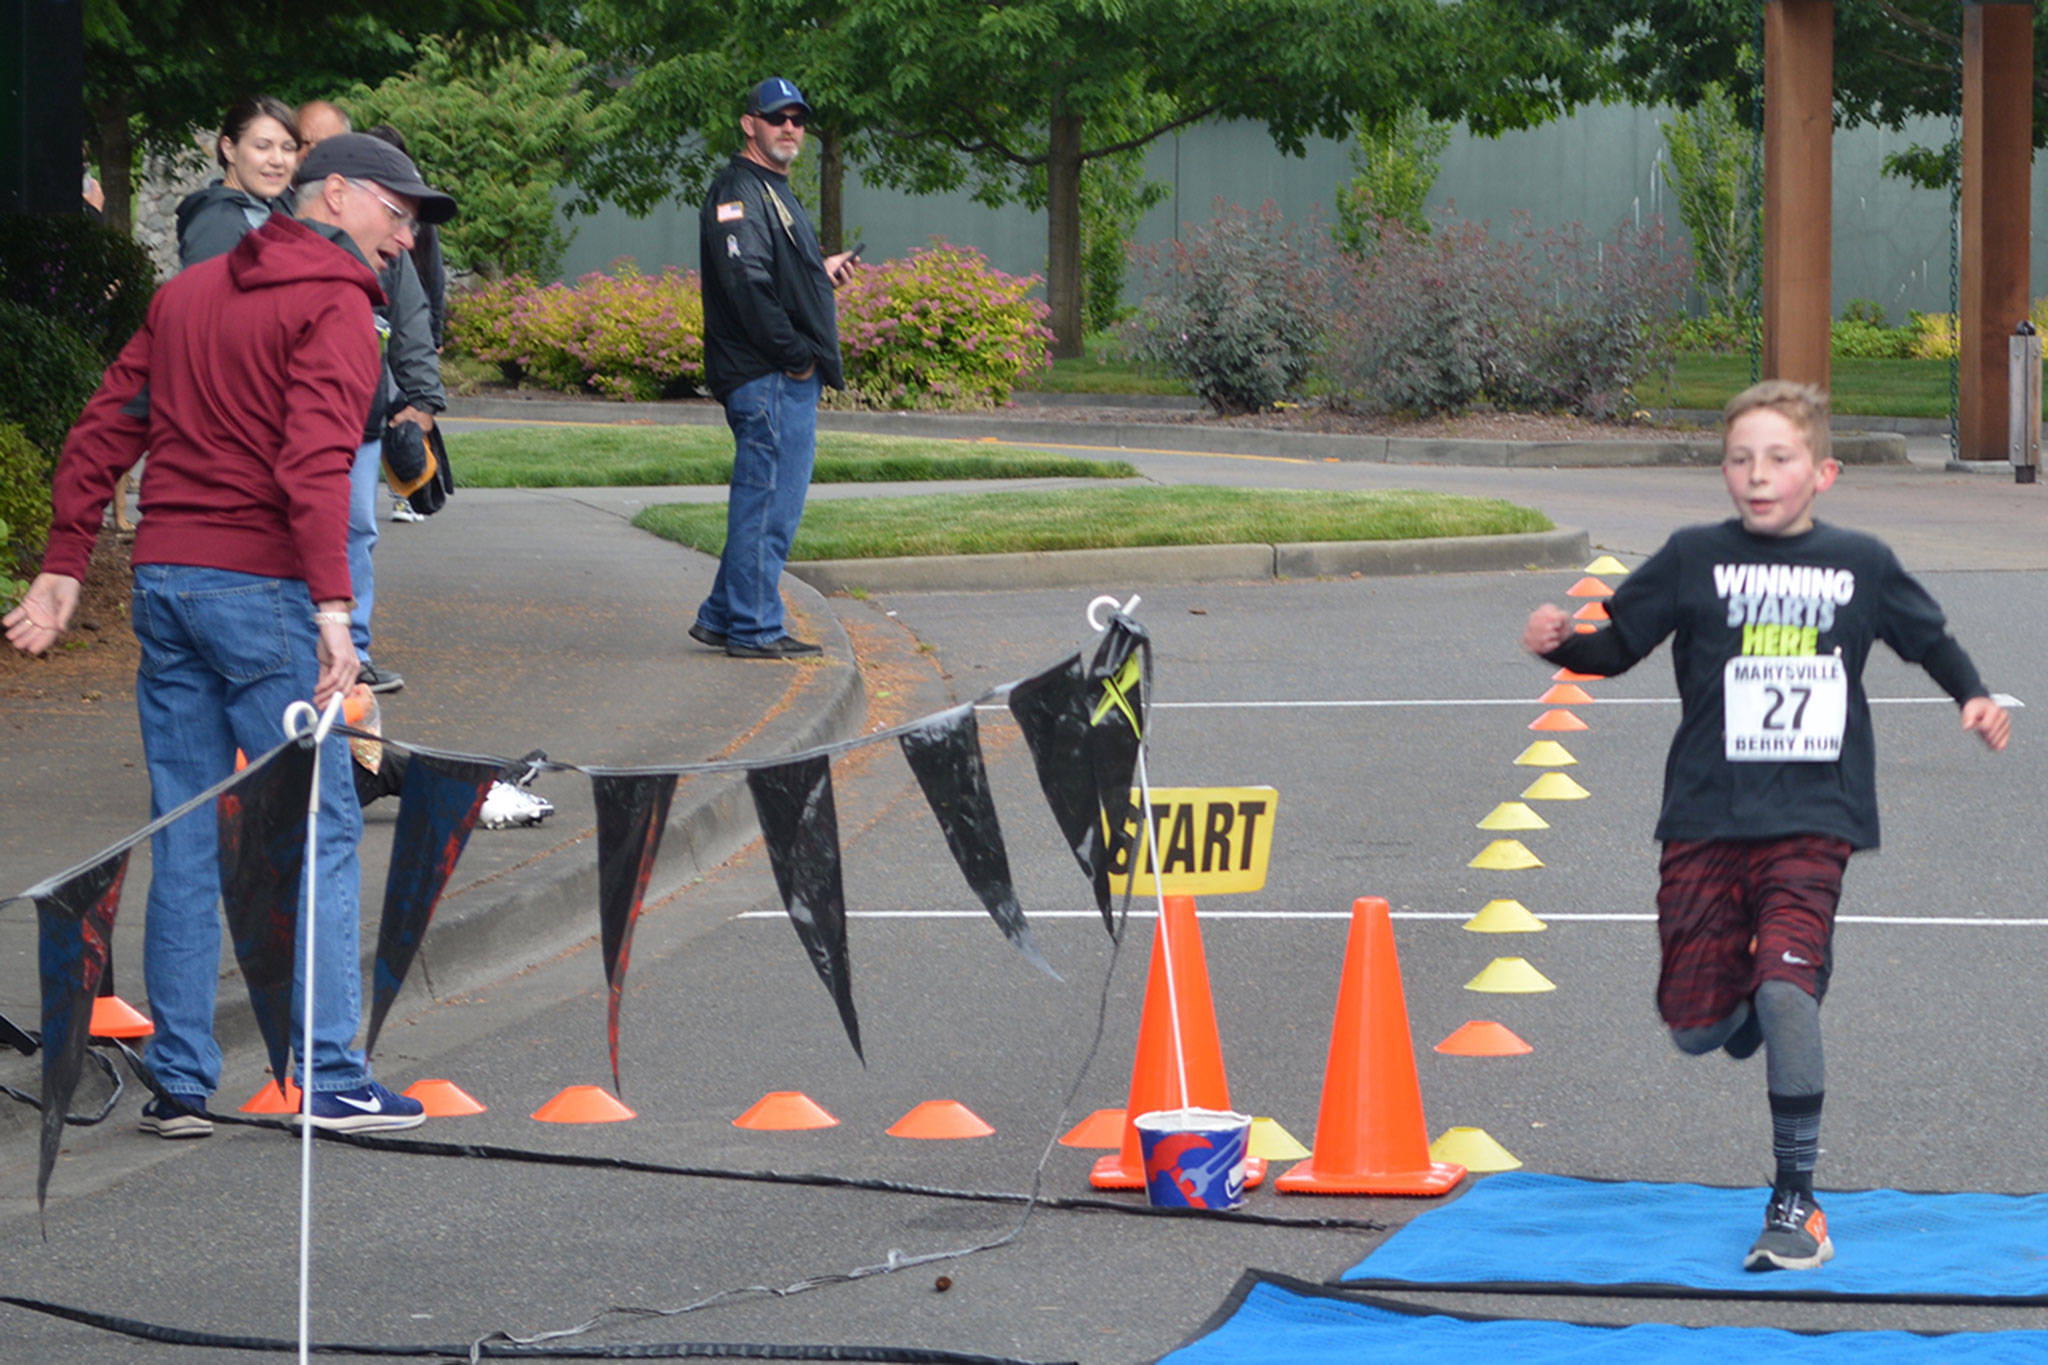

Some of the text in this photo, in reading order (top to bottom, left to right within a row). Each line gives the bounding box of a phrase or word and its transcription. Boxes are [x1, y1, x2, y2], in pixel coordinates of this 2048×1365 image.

[1714, 564, 1855, 605] WINNING
[1727, 597, 1836, 632] STARTS
[1742, 623, 1819, 656] HERE
[1735, 664, 1839, 680] MARYSVILLE
[1763, 686, 1812, 730] 27
[1736, 735, 1840, 751] BERRY RUN
